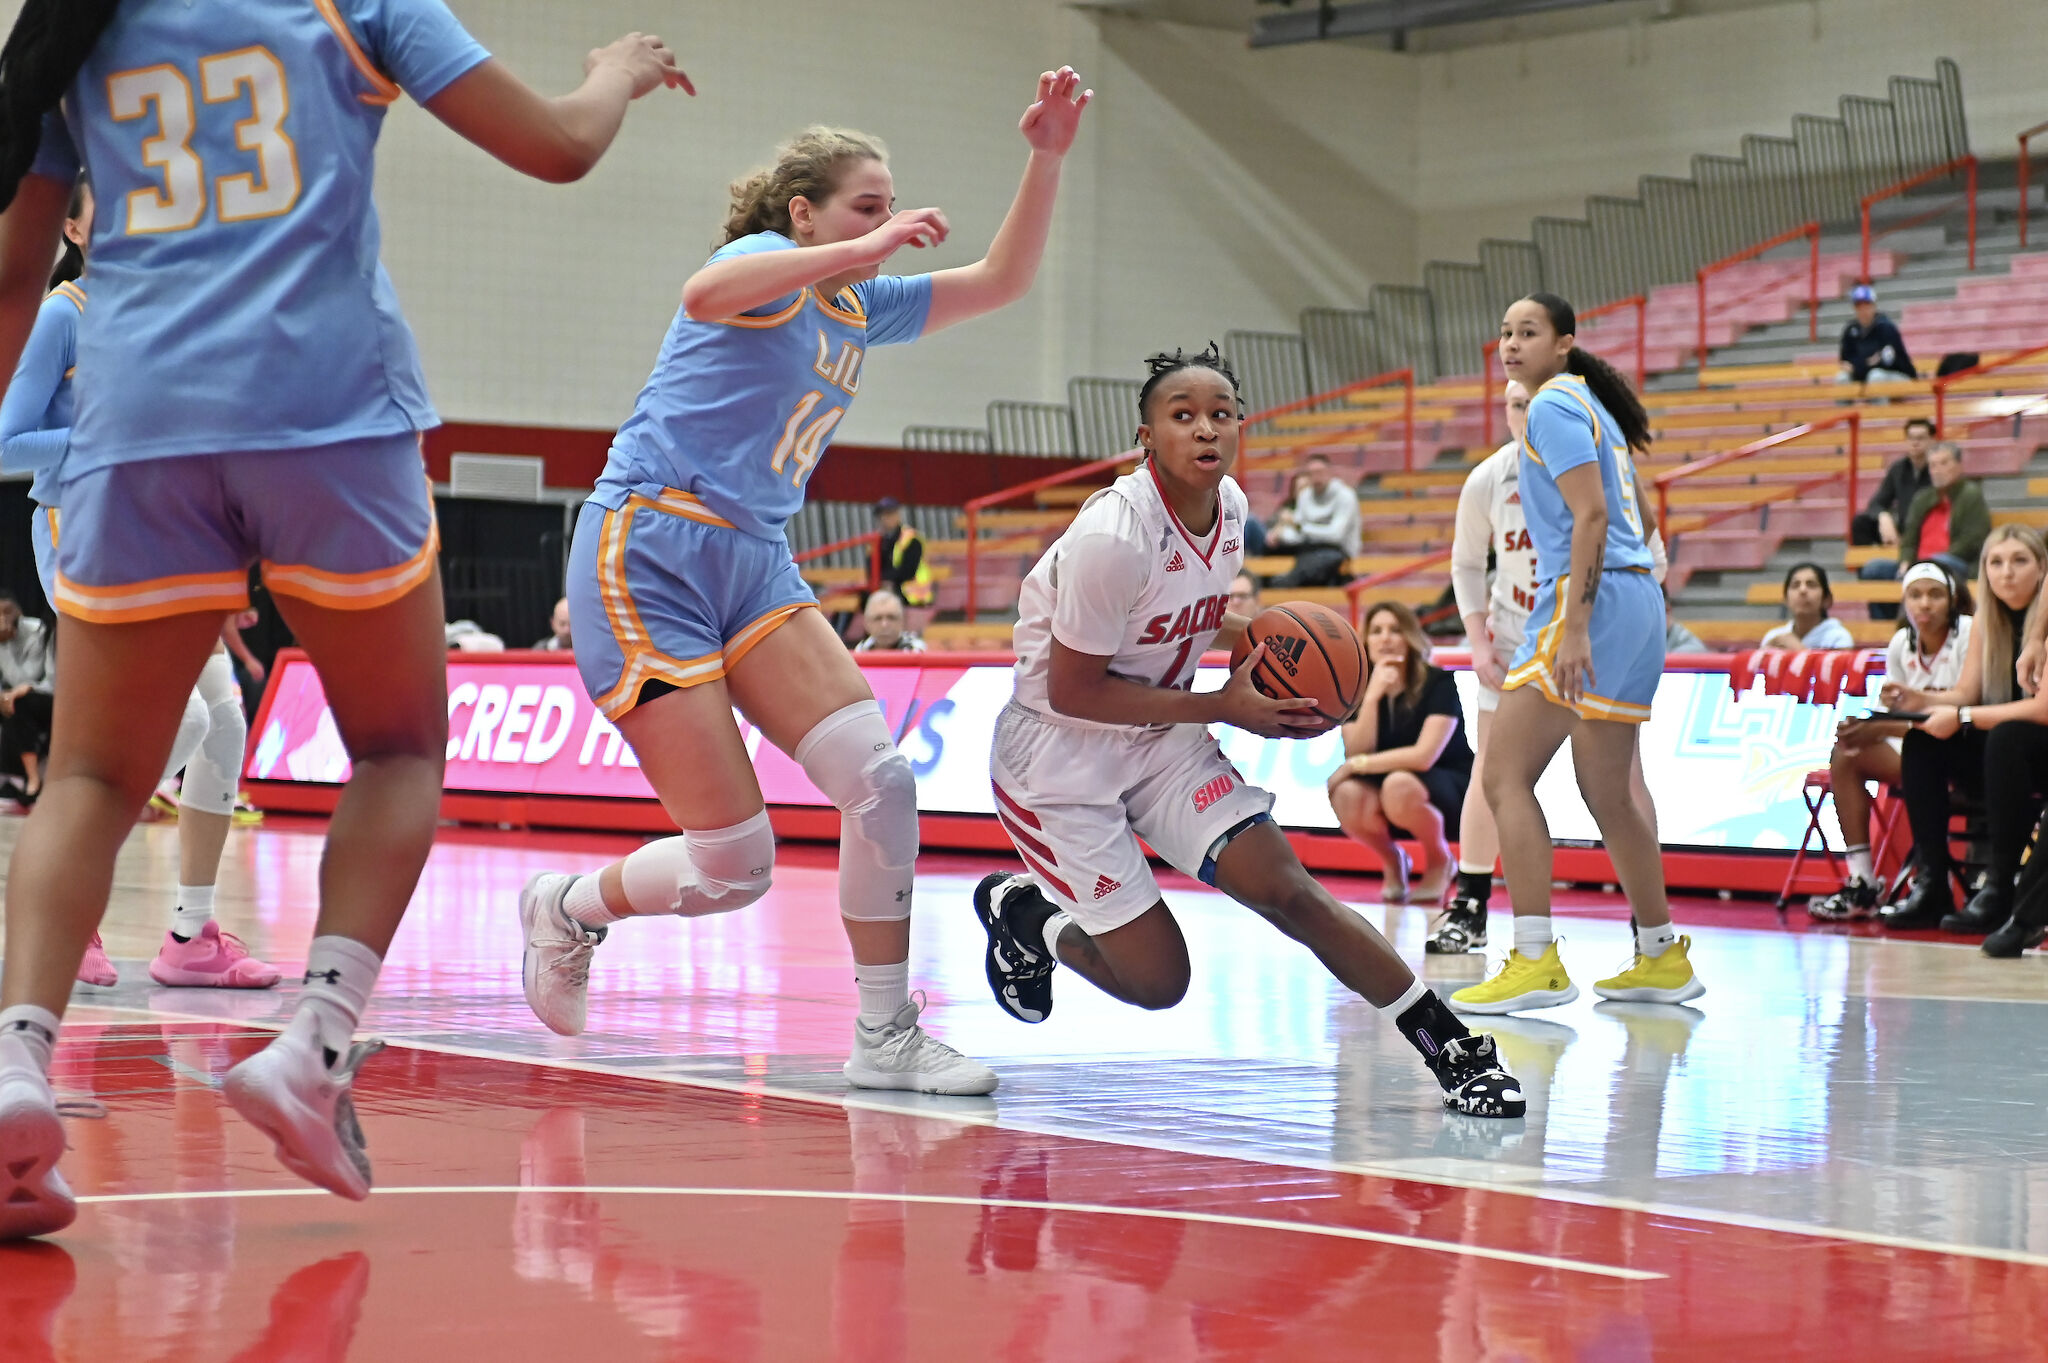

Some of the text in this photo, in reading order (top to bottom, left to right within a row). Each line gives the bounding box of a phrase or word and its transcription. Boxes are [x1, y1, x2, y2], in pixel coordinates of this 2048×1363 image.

[106, 44, 301, 236] 33
[813, 328, 863, 397] LIU
[770, 389, 846, 489] 14
[1136, 593, 1230, 646] SACRE
[1264, 635, 1298, 678] adidas
[445, 682, 576, 764] CRED
[1191, 773, 1235, 813] SHU
[1093, 880, 1122, 900] adidas
